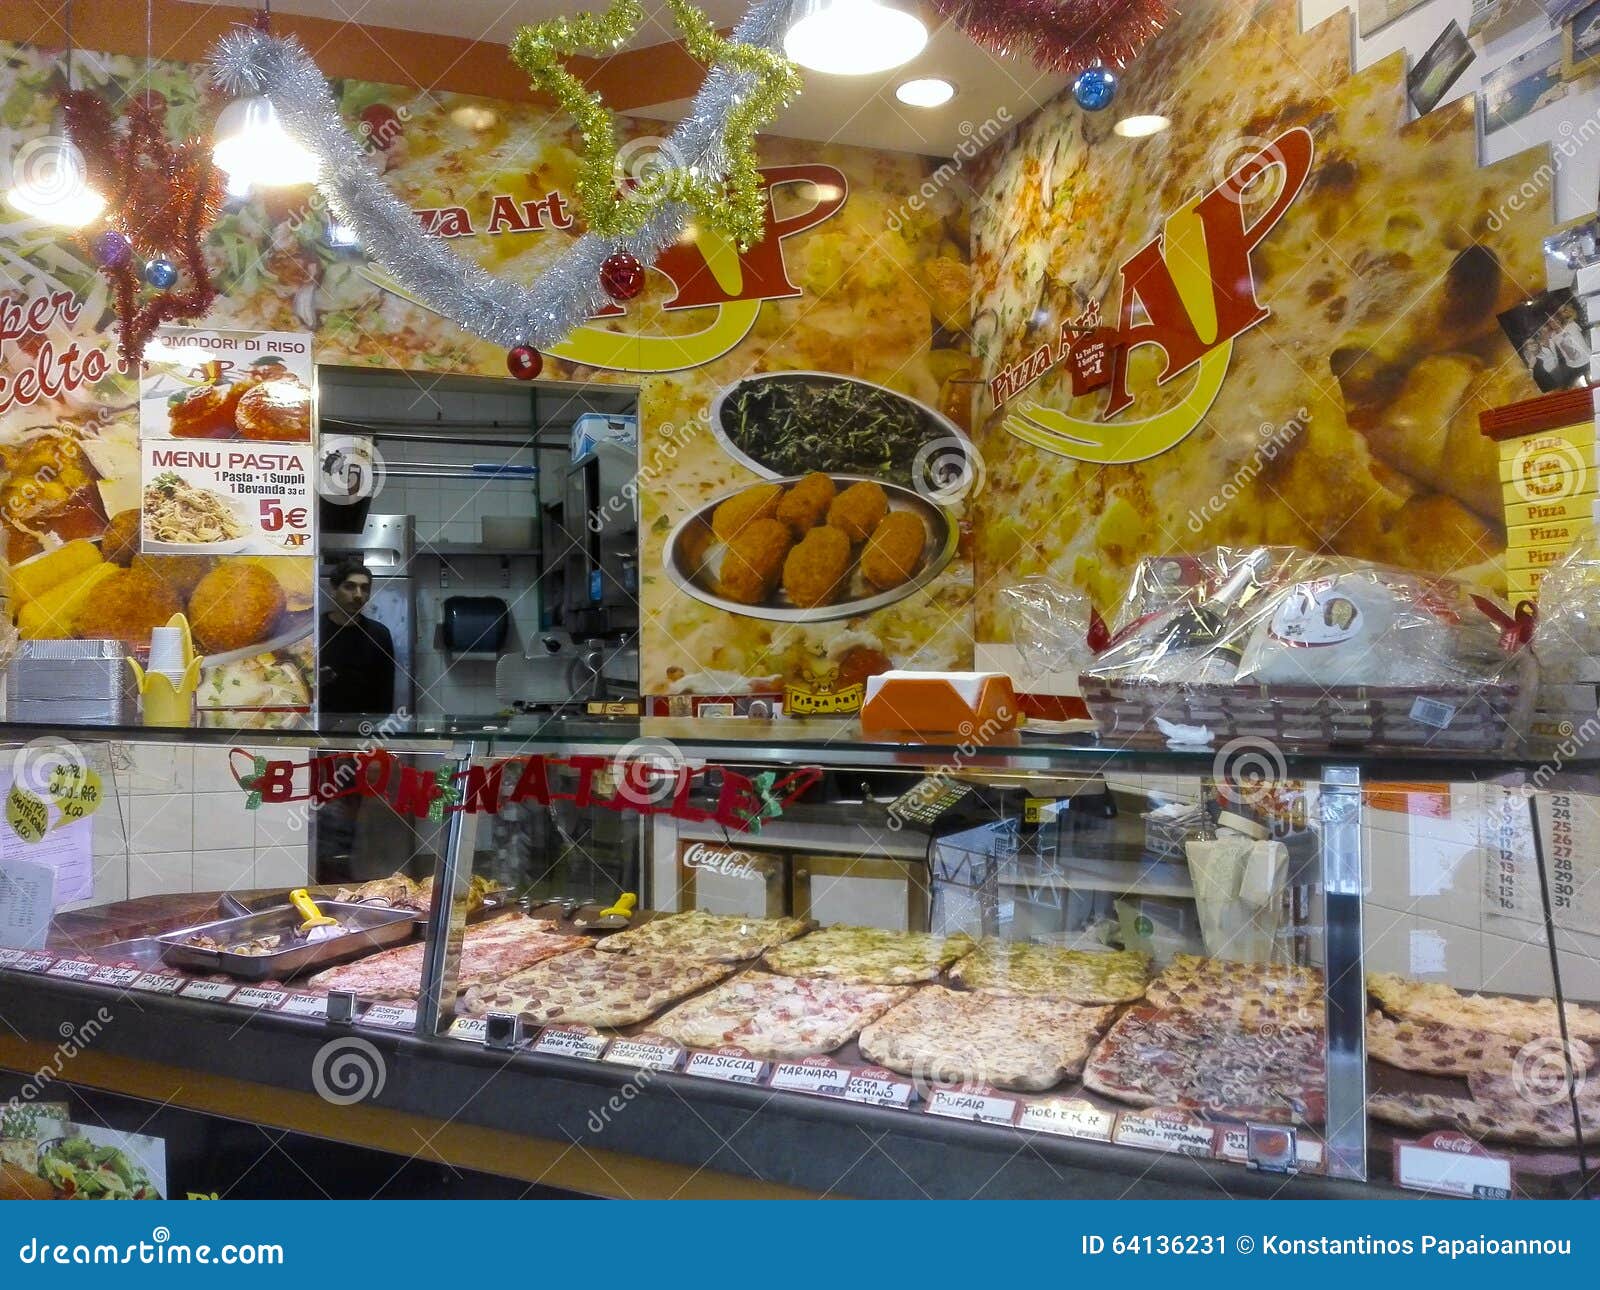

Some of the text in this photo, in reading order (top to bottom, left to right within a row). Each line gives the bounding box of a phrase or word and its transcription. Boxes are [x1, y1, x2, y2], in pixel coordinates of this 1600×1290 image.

[488, 190, 573, 234] Art
[161, 335, 305, 354] OMODORI DI RISO
[990, 344, 1054, 410] Pizza
[152, 450, 304, 471] MENU PASTA
[214, 471, 220, 481] 1
[222, 471, 253, 482] Pasta
[262, 472, 268, 483] 1
[230, 483, 236, 493] 1
[237, 483, 285, 495] Bevanda
[287, 487, 297, 495] 33
[1528, 505, 1566, 519] Pizza
[1530, 527, 1569, 541] Pizza
[794, 694, 829, 707] PIZZA
[1552, 795, 1570, 807] 23
[1552, 808, 1571, 820] 24
[1552, 821, 1571, 833] 25
[1552, 833, 1572, 846] 26
[1500, 850, 1513, 861] 12
[1553, 846, 1572, 858] 27
[1500, 861, 1515, 874] 13
[1554, 858, 1572, 870] 28
[1500, 873, 1514, 885] 14
[1554, 870, 1573, 883] 29
[1499, 886, 1513, 897] 15
[1554, 883, 1573, 896] 30
[1499, 898, 1514, 909] 16
[1555, 896, 1571, 908] 31
[142, 973, 178, 989] PASTA
[692, 1054, 756, 1074] SALSICCIA
[778, 1063, 838, 1080] MARINARA
[1024, 1105, 1056, 1117] FIORI
[1154, 1120, 1189, 1132] POLLO
[1433, 1136, 1473, 1153] Coca-Cola
